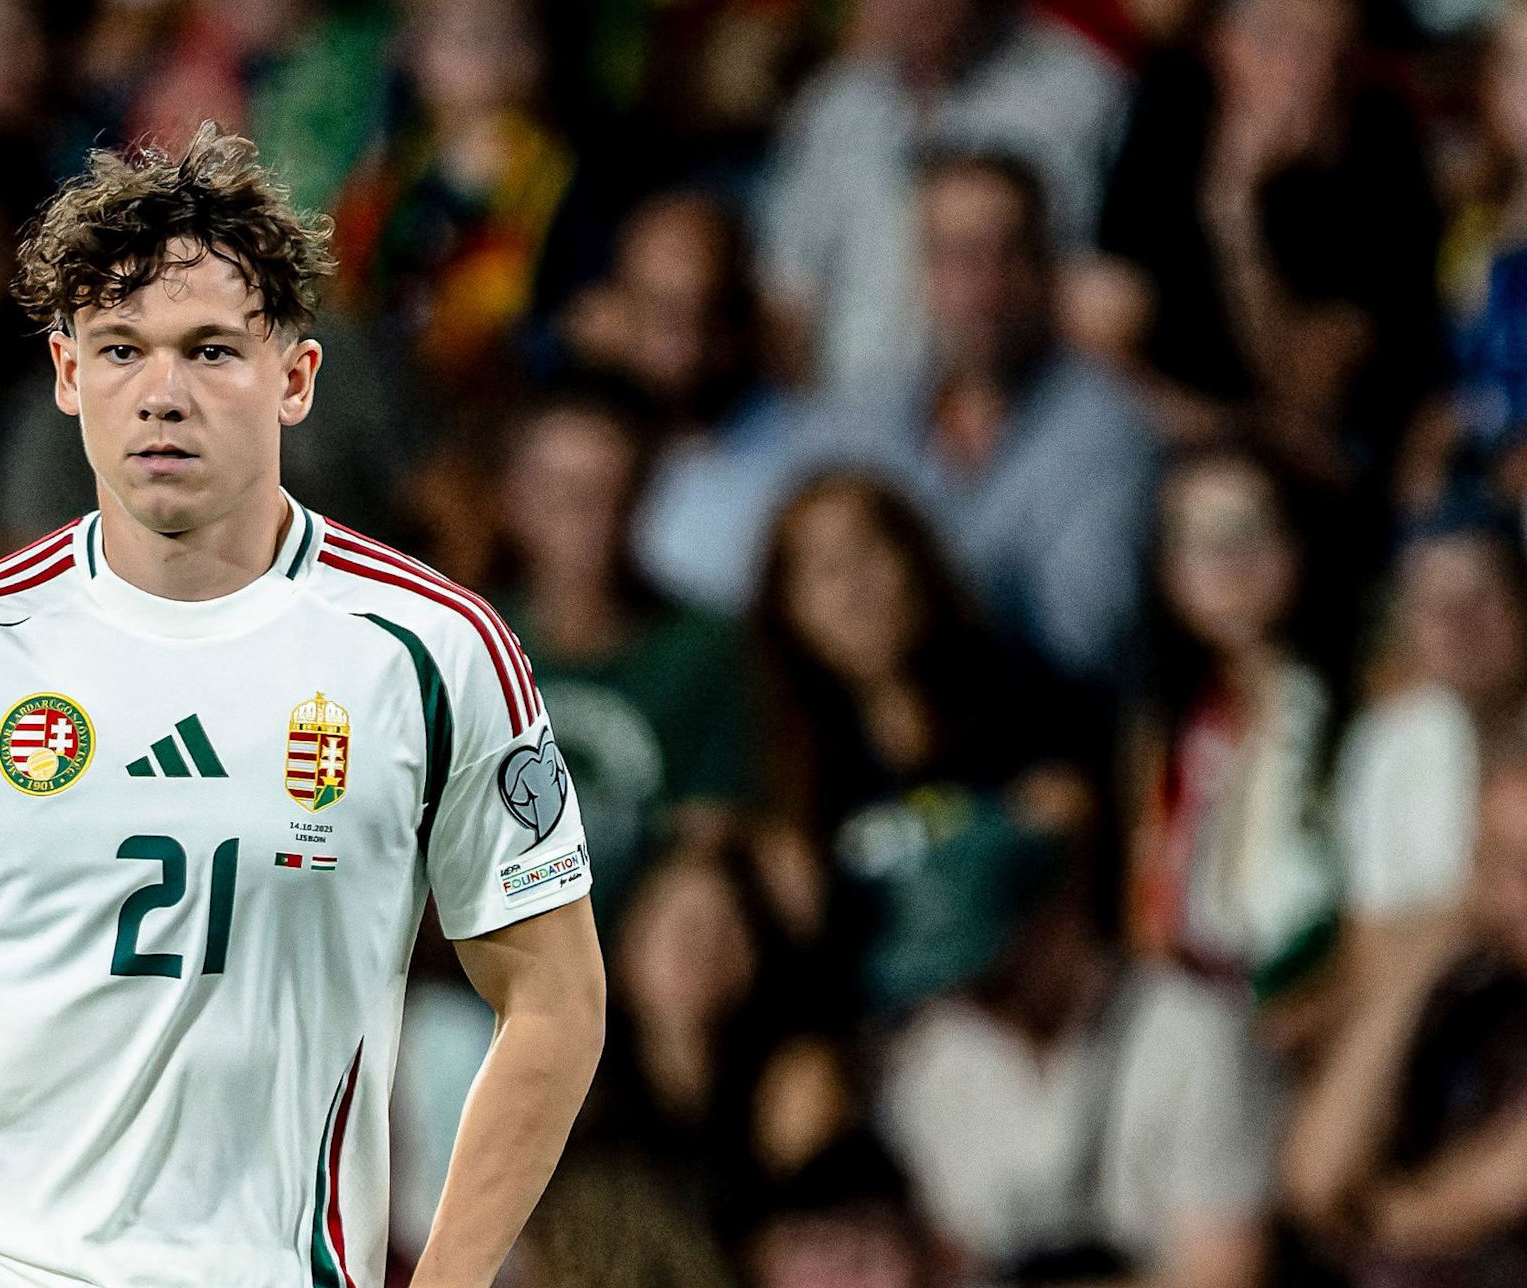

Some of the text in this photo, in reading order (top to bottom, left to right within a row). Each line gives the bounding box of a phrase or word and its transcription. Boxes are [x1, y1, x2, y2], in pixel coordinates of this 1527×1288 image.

[26, 780, 55, 790] 1901
[503, 854, 579, 893] FOUNDATION
[111, 835, 239, 979] 21
